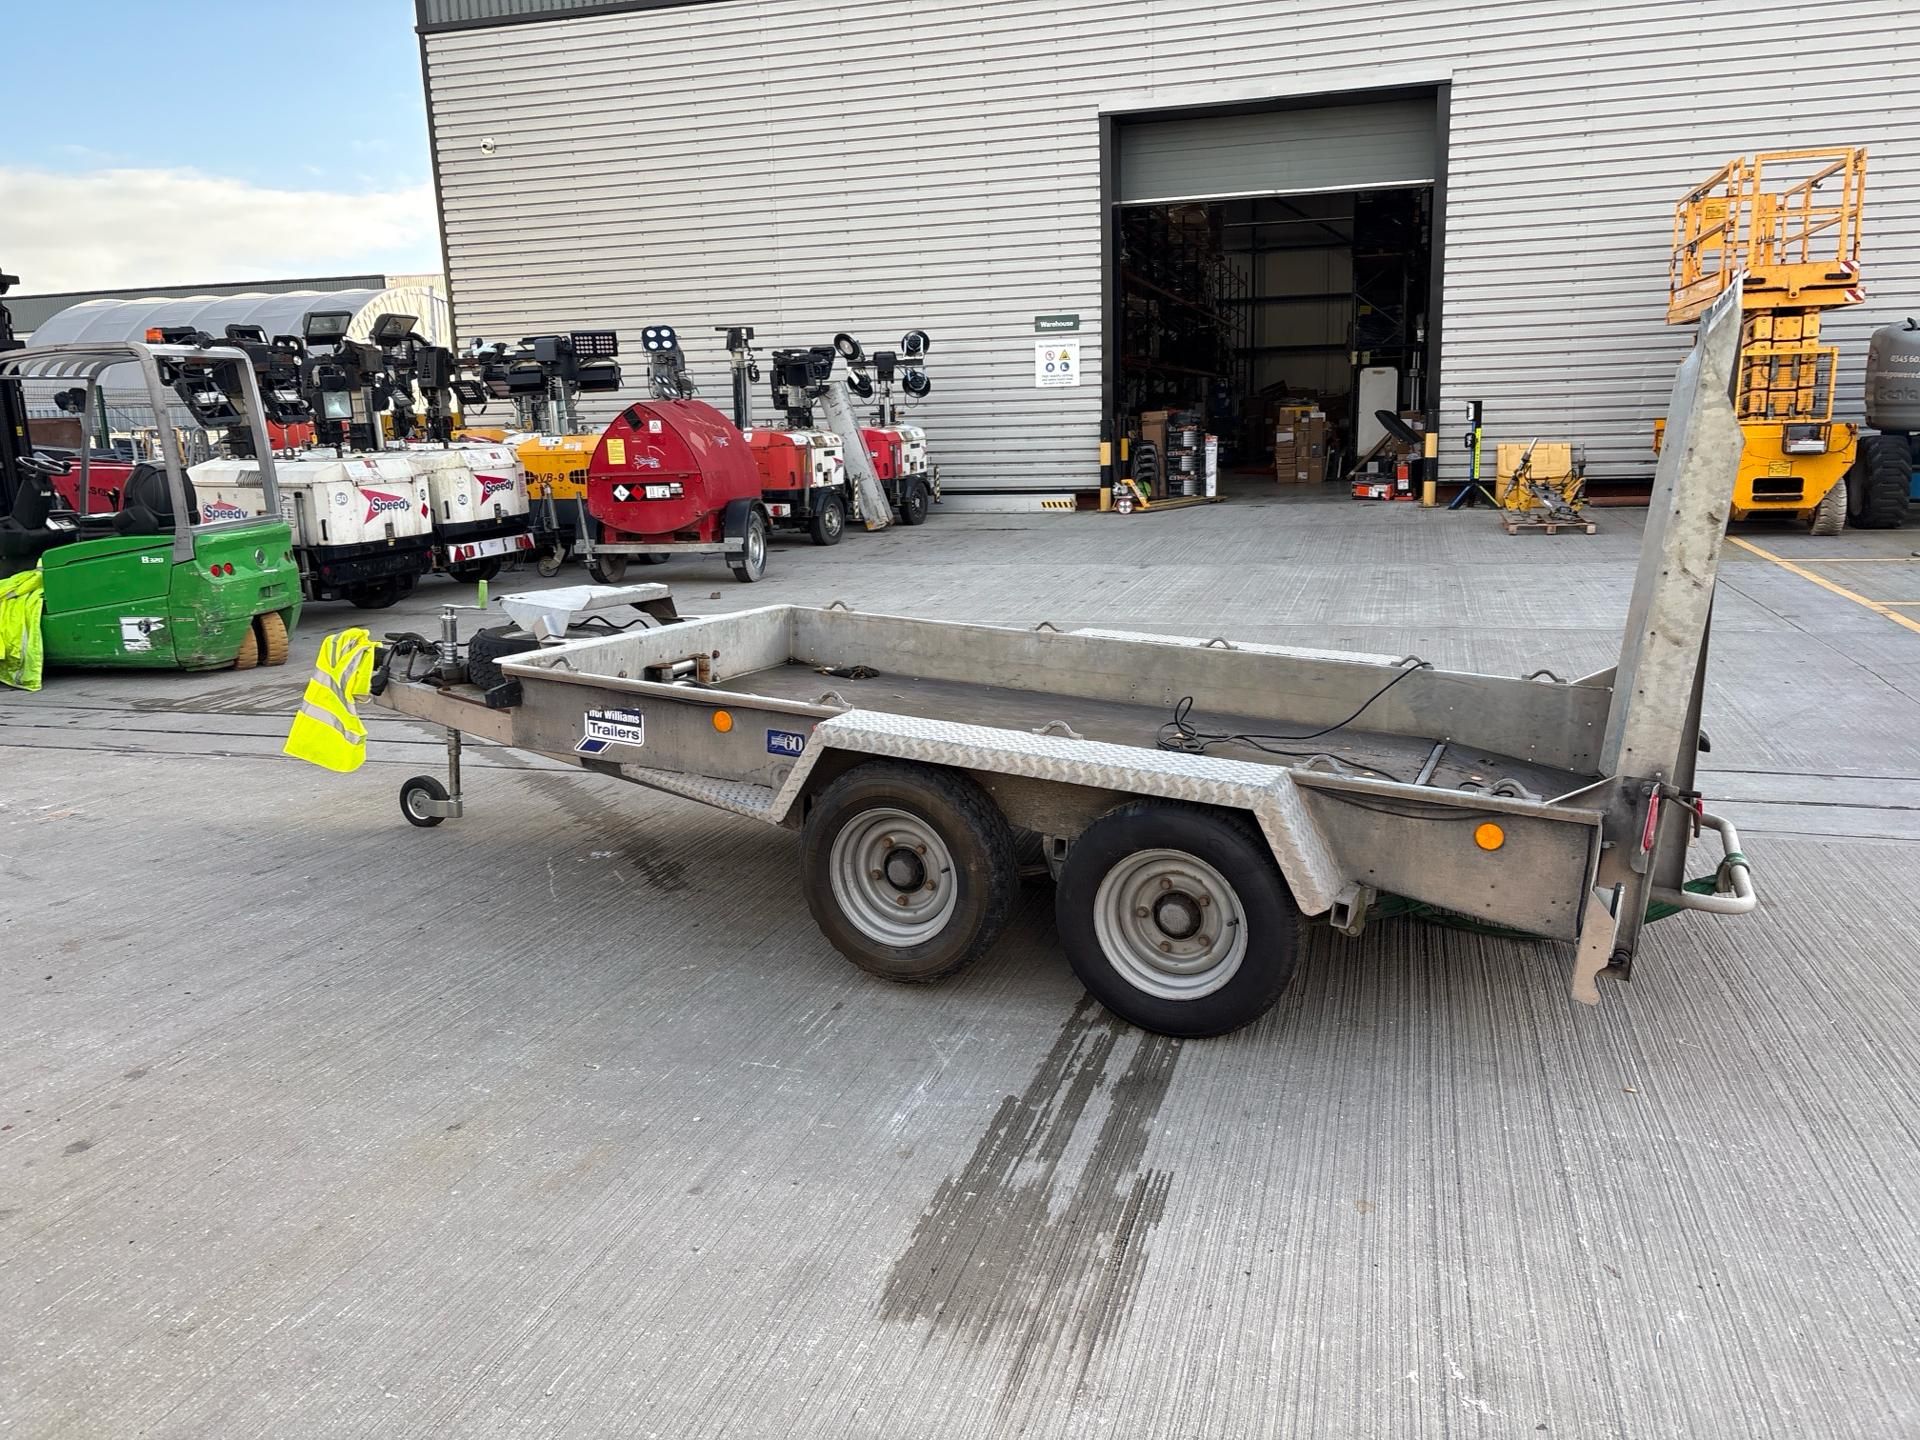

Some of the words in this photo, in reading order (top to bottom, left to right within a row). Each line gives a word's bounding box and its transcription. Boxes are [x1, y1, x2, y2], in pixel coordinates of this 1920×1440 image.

[1909, 355, 1920, 363] 60
[485, 479, 514, 494] Speedy
[336, 495, 348, 503] 50
[372, 498, 411, 513] Speedy
[604, 710, 640, 724] Williams
[590, 722, 640, 740] Trailers
[784, 735, 804, 752] 60
